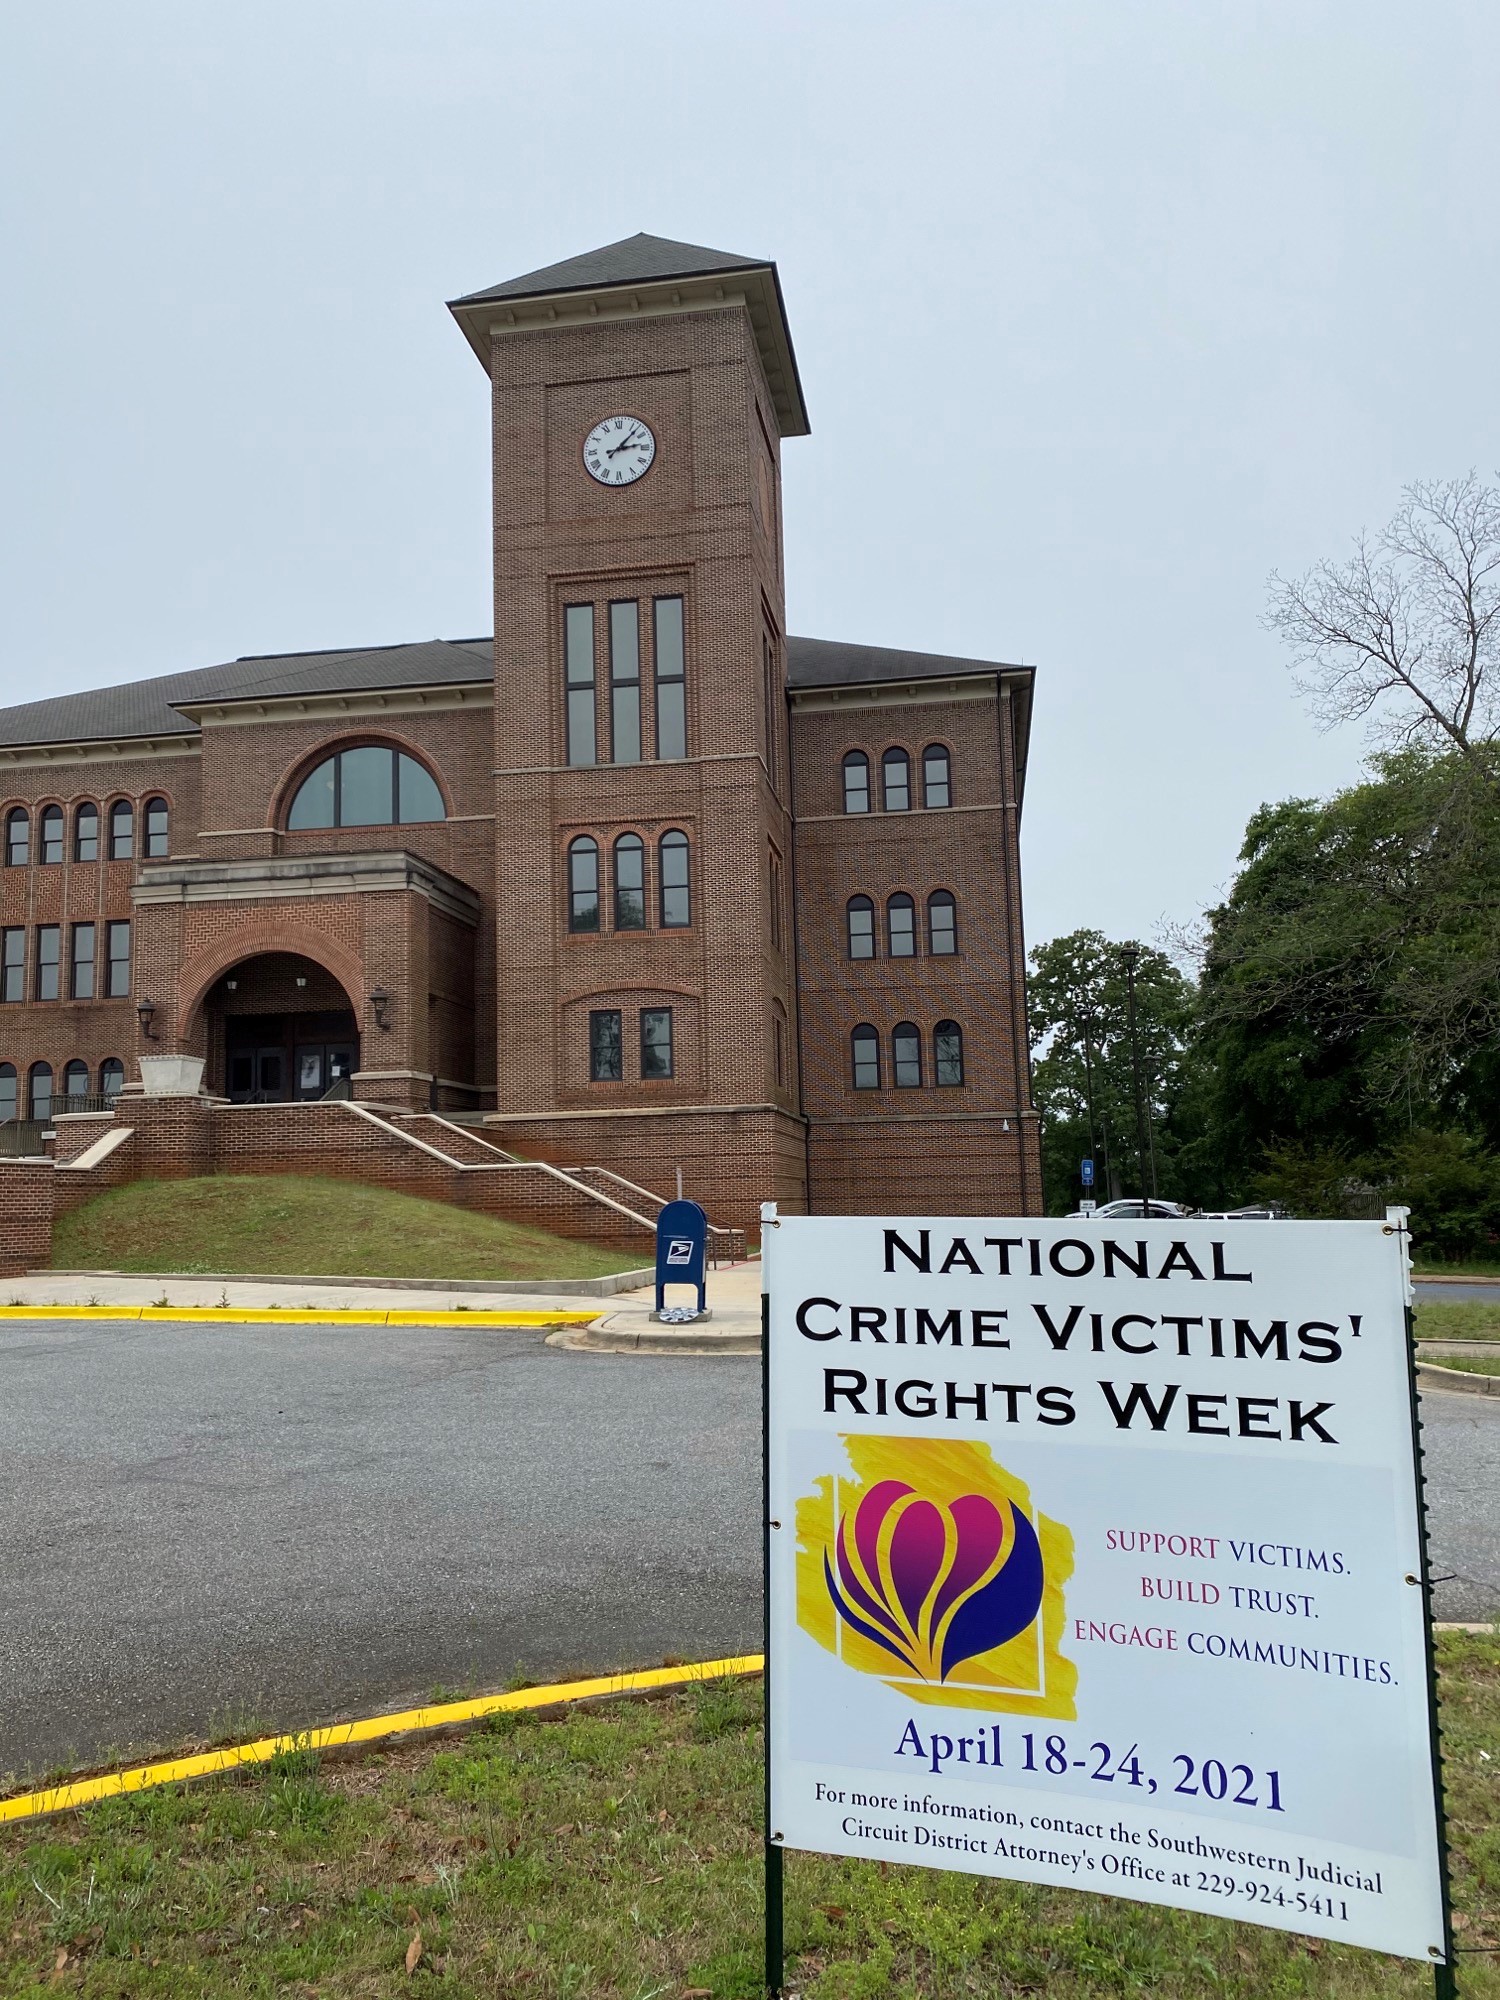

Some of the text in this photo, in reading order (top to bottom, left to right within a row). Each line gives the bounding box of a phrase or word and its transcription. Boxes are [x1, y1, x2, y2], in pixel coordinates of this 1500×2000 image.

[882, 1229, 1253, 1284] NATIONAL
[795, 1297, 1363, 1364] CRIME VICTIMS'
[822, 1368, 1340, 1445] RIGHTS WEEK
[1106, 1529, 1351, 1575] SUPPORT VICTIMS.
[1141, 1576, 1319, 1619] BUILD TRUST.
[1074, 1619, 1399, 1686] ENGAGE COMMUNITIES.
[893, 1718, 1286, 1812] April 18-24, 2021
[815, 1782, 1383, 1895] For more information, contact the Southwestern Judicial
[842, 1817, 1348, 1921] Circuit District Attorney's Office at 229-924-5411
